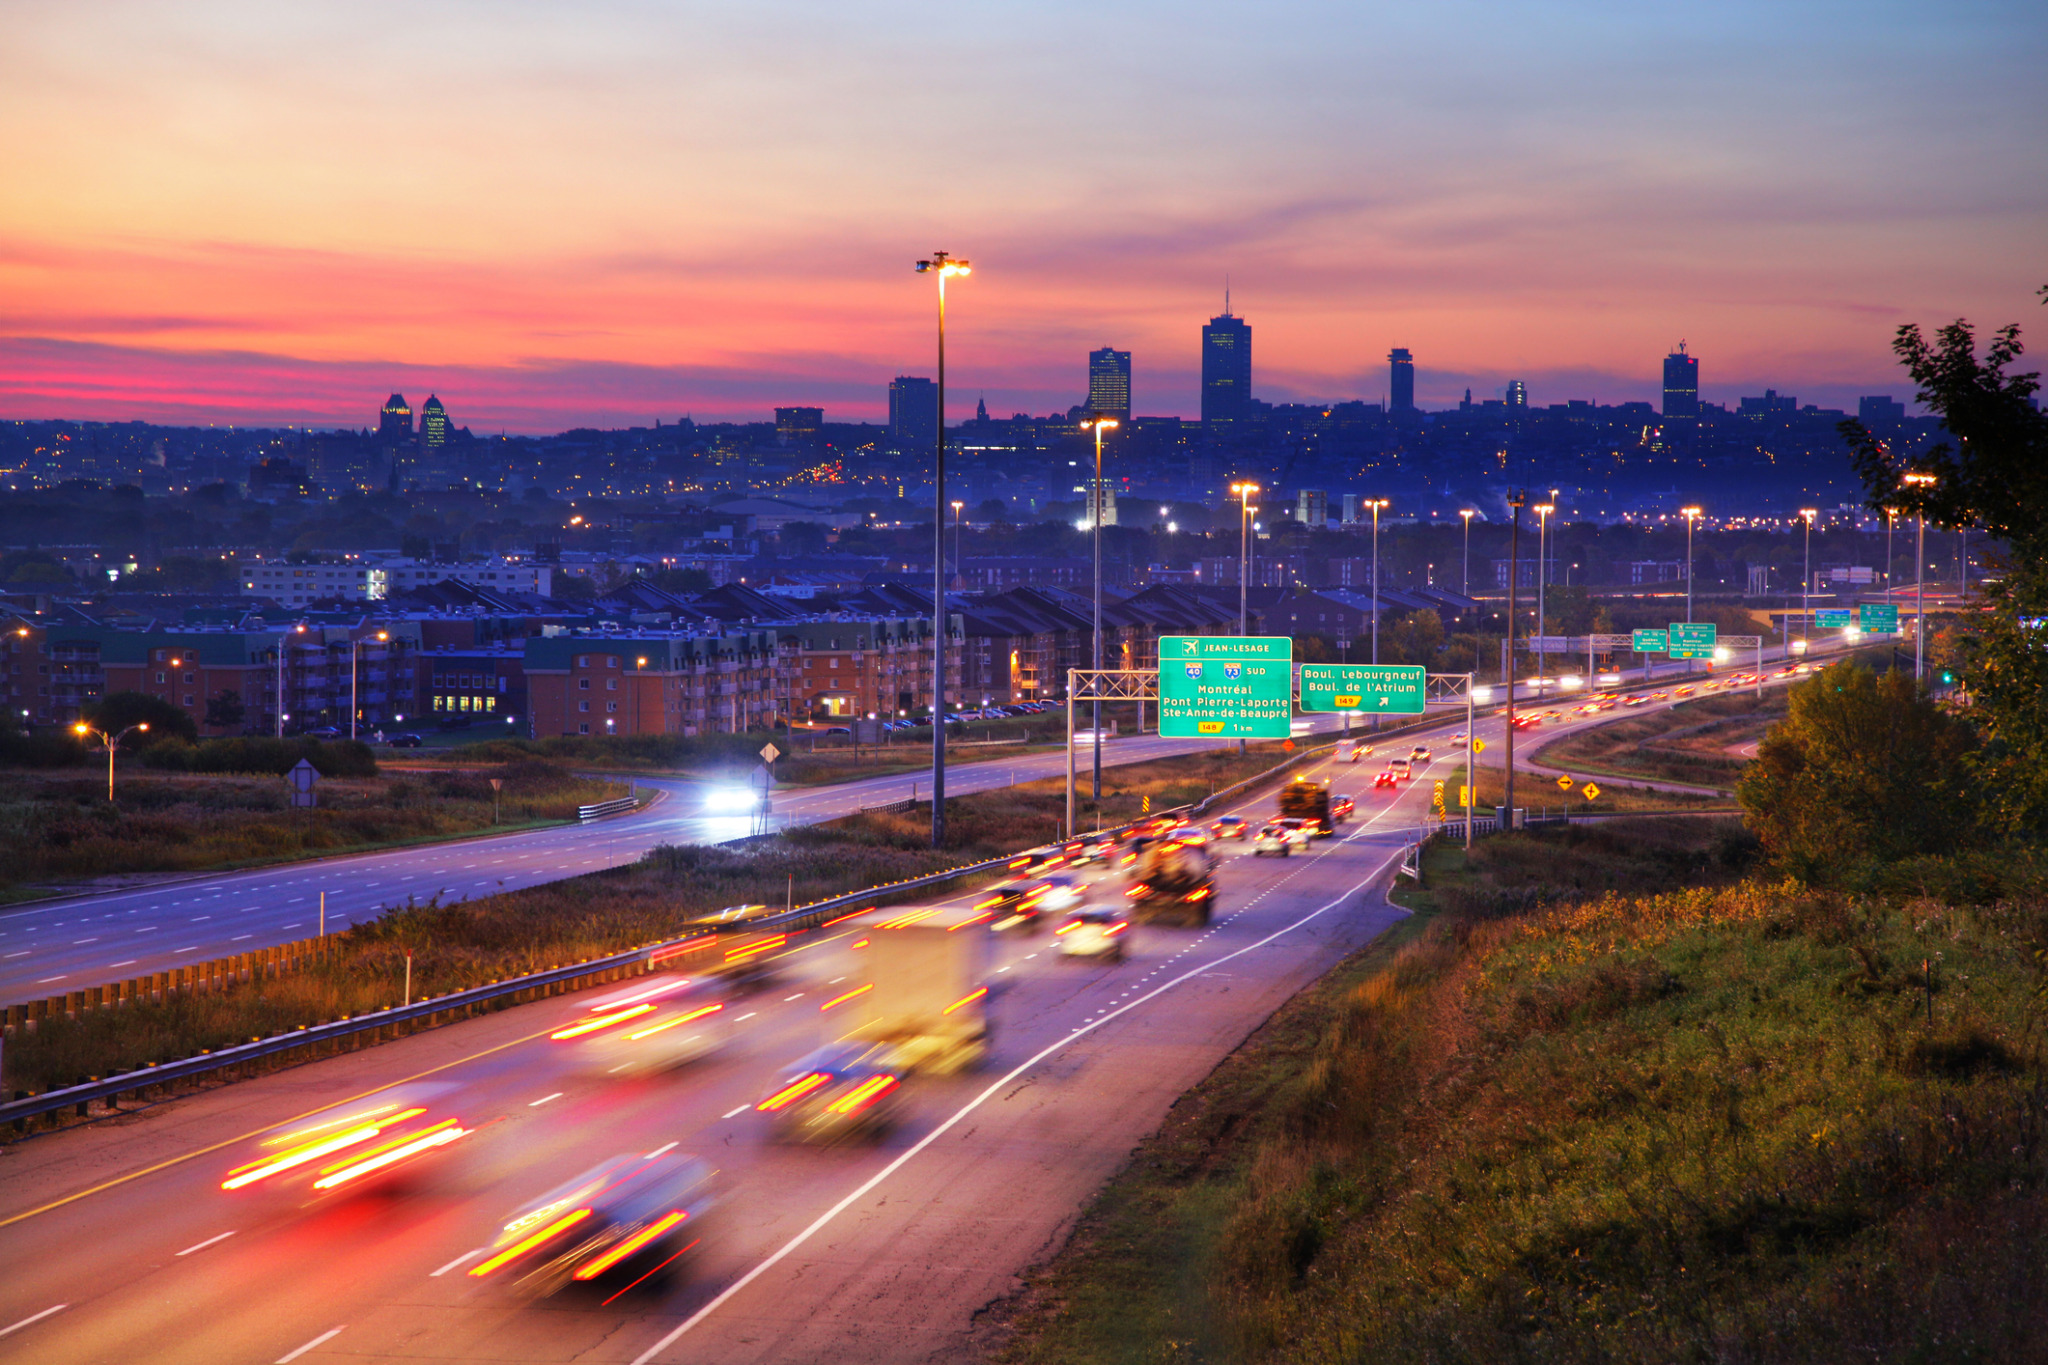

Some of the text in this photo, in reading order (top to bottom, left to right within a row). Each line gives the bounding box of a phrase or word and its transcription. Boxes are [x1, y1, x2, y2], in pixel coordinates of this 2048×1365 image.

[1203, 644, 1270, 652] JEAN-LESAGE
[1227, 668, 1239, 676] 73
[1246, 667, 1266, 675] SUD
[1304, 669, 1420, 682] Boul. Lebourgneuf
[1198, 684, 1252, 694] Montréal
[1308, 682, 1416, 692] Boul. de l'Atrium
[1163, 697, 1288, 708] Pont Pierre-Laporte
[1163, 708, 1288, 720] Ste-Anne-de-Beaupré
[1233, 724, 1238, 732] 1
